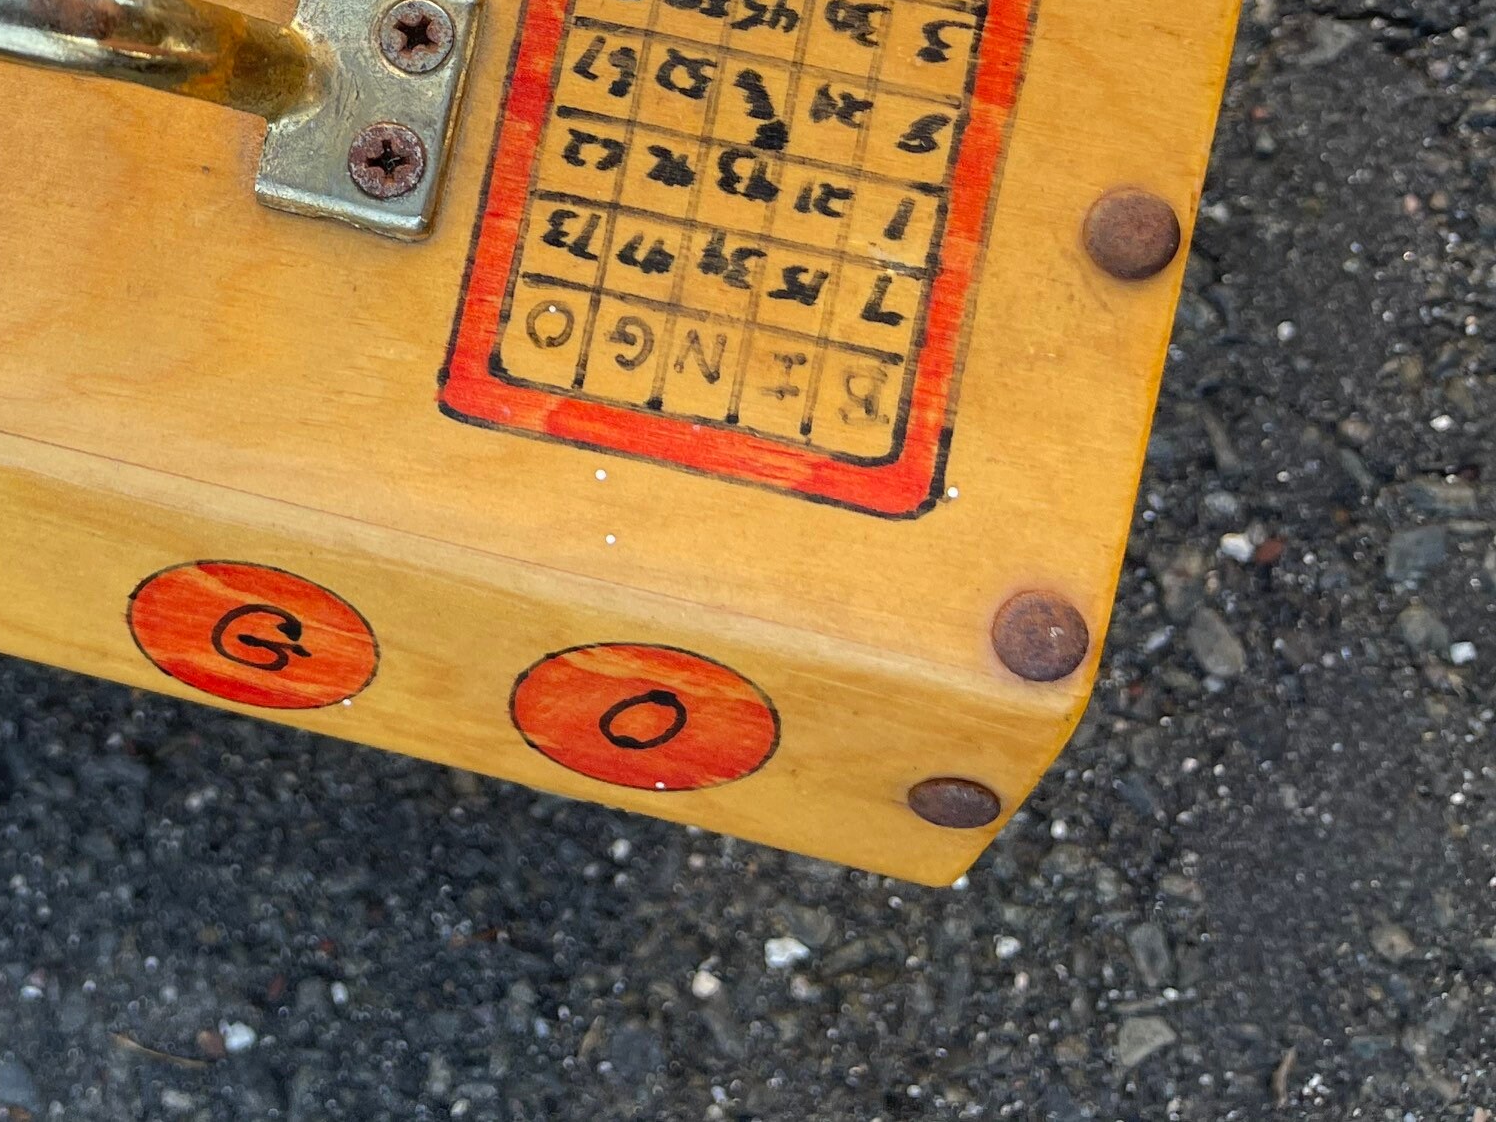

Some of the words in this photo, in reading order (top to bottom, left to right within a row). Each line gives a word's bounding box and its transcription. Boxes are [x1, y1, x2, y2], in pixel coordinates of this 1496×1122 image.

[541, 208, 600, 261] 73
[860, 275, 904, 327] 7
[604, 315, 654, 370] G
[673, 330, 727, 384] N
[210, 604, 312, 672] G
